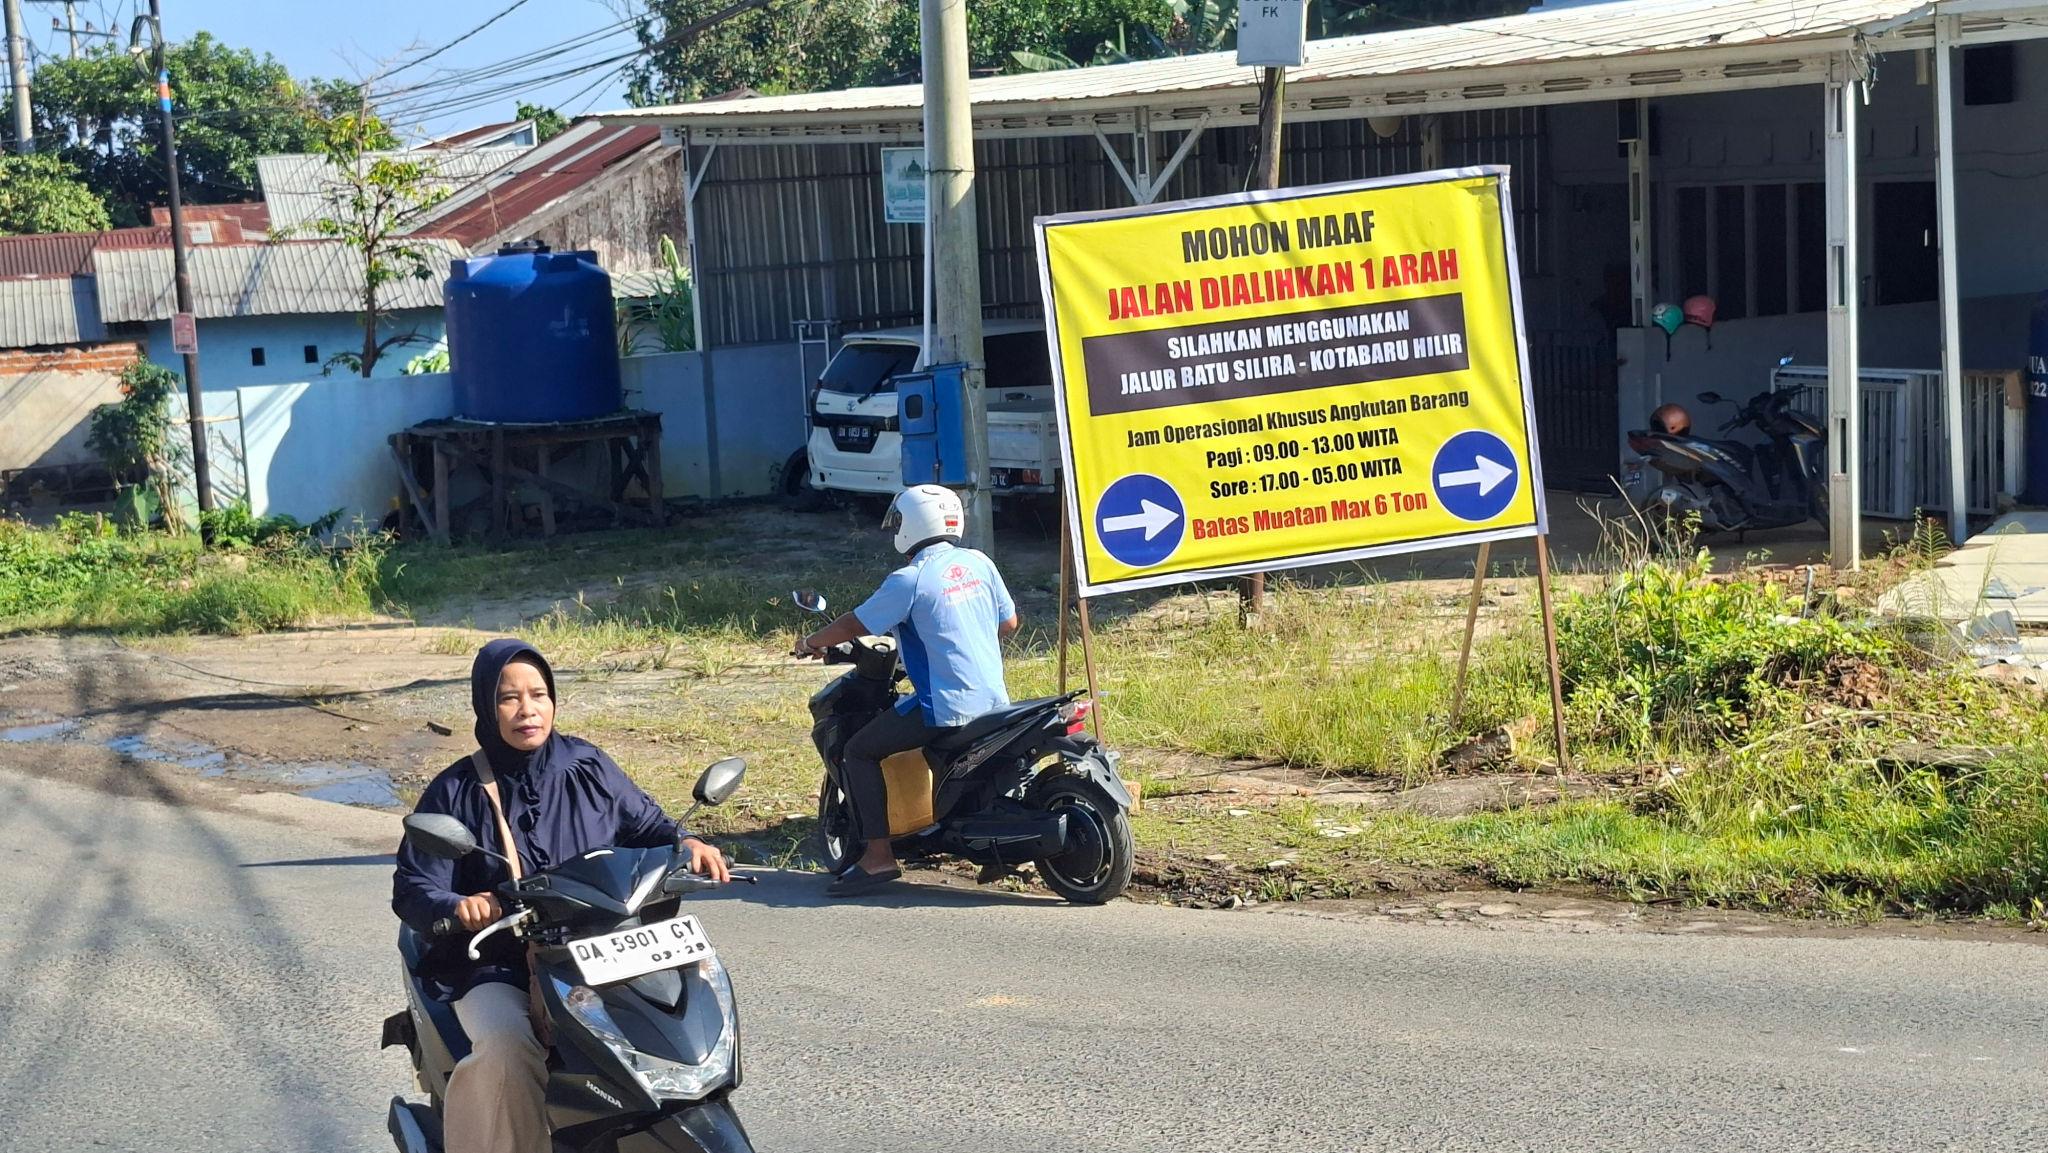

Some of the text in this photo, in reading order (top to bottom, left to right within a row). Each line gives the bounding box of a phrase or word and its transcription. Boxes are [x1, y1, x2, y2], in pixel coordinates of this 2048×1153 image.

[1262, 6, 1279, 18] FK
[1181, 210, 1375, 263] MOHON MAAF
[1108, 248, 1459, 321] JALAN DIALIHKAN 1 ARAH
[1167, 310, 1410, 359] SILAHKAN MENGGUNAKAN
[1120, 369, 1177, 395] JALUR
[1181, 361, 1230, 387] BATU
[1233, 354, 1296, 381] SILIRA
[1310, 339, 1409, 372] KOTABARU
[1412, 333, 1463, 359] HILIR
[1127, 390, 1469, 448] Jam Operasional Khusus Angkutan Barang
[1206, 447, 1243, 468] Pagi
[1253, 440, 1299, 462] 09.00
[1311, 433, 1354, 455] 13.00
[1357, 427, 1399, 449] WITA
[1210, 480, 1248, 499] Sore
[1259, 471, 1300, 492] 17.00
[1312, 463, 1358, 485] 05.00
[1361, 457, 1402, 479] WITA
[1192, 492, 1427, 540] Batas Muatan Max 6 Ton
[576, 920, 695, 961] DA 5901 GY
[585, 1080, 623, 1109] HONDA
